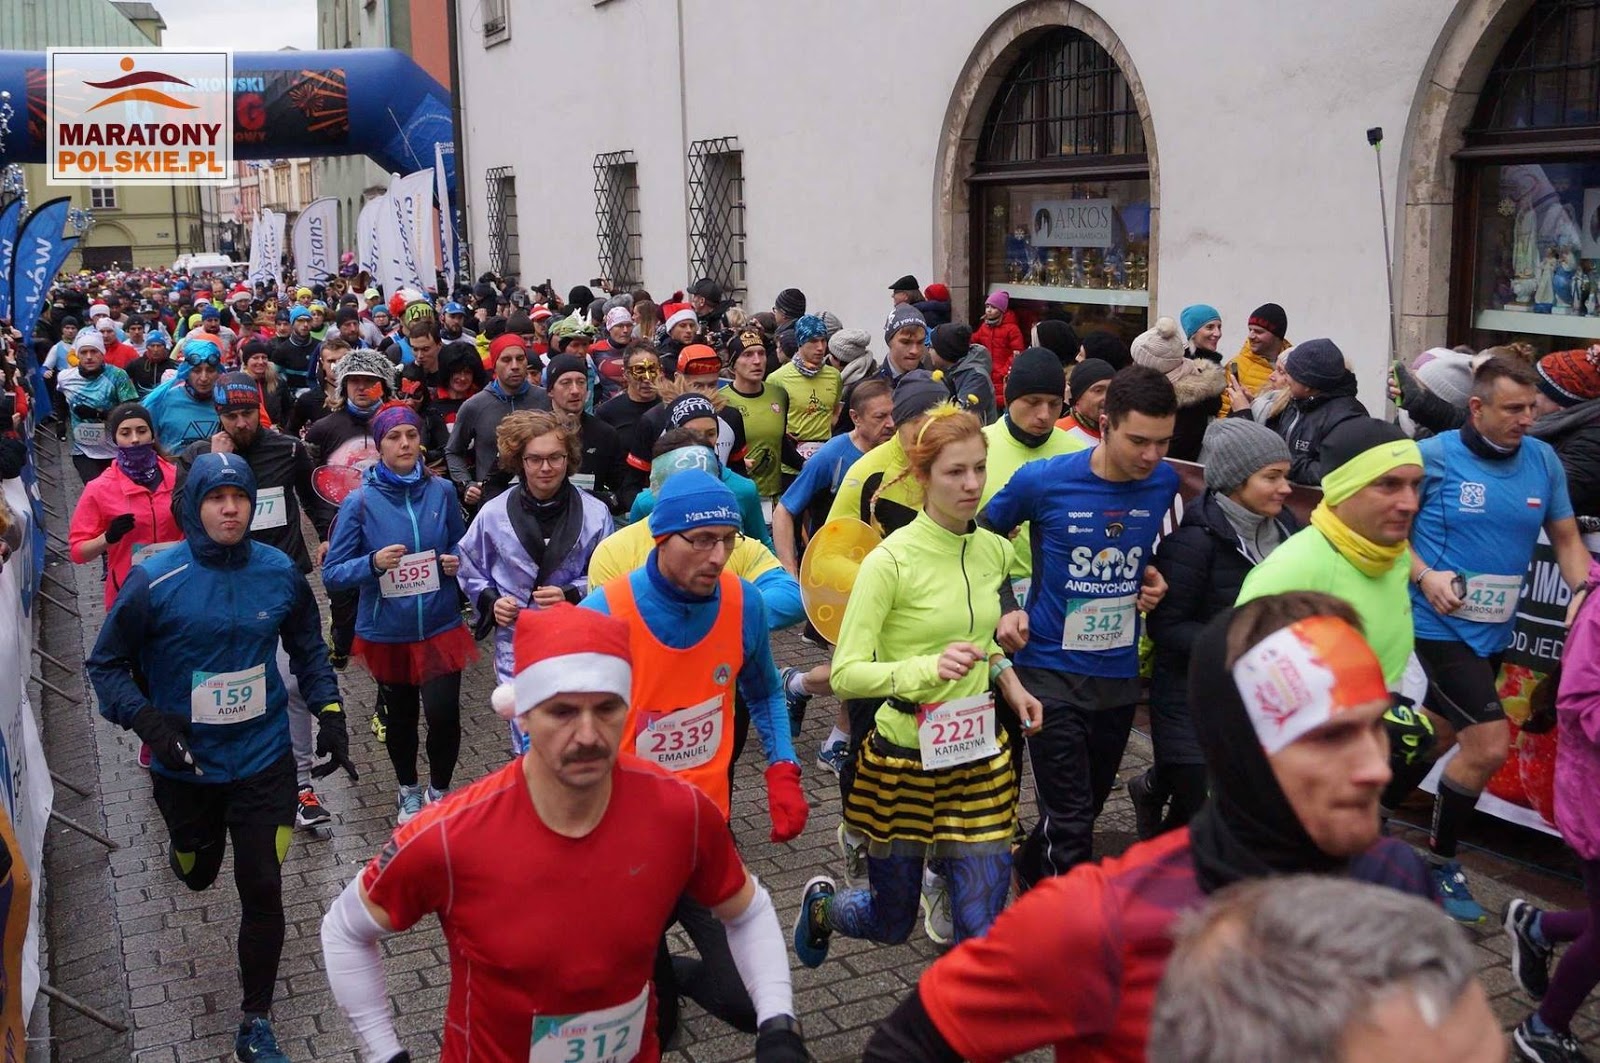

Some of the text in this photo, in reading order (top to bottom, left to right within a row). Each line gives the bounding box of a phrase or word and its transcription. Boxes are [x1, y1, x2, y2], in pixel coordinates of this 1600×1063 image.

[1055, 206, 1108, 228] ARKOS
[79, 430, 101, 438] 1002
[1068, 546, 1143, 581] SOS
[388, 564, 431, 584] 1595
[395, 580, 426, 590] PAULINA
[1470, 589, 1507, 606] 424
[1083, 614, 1123, 633] 342
[212, 685, 253, 706] 159
[218, 705, 247, 715] ADAM
[650, 720, 714, 753] 2339
[931, 715, 984, 745] 2221
[658, 745, 708, 762] EMANUEL
[934, 737, 986, 757] KATARZYNA
[565, 1026, 630, 1063] 312
